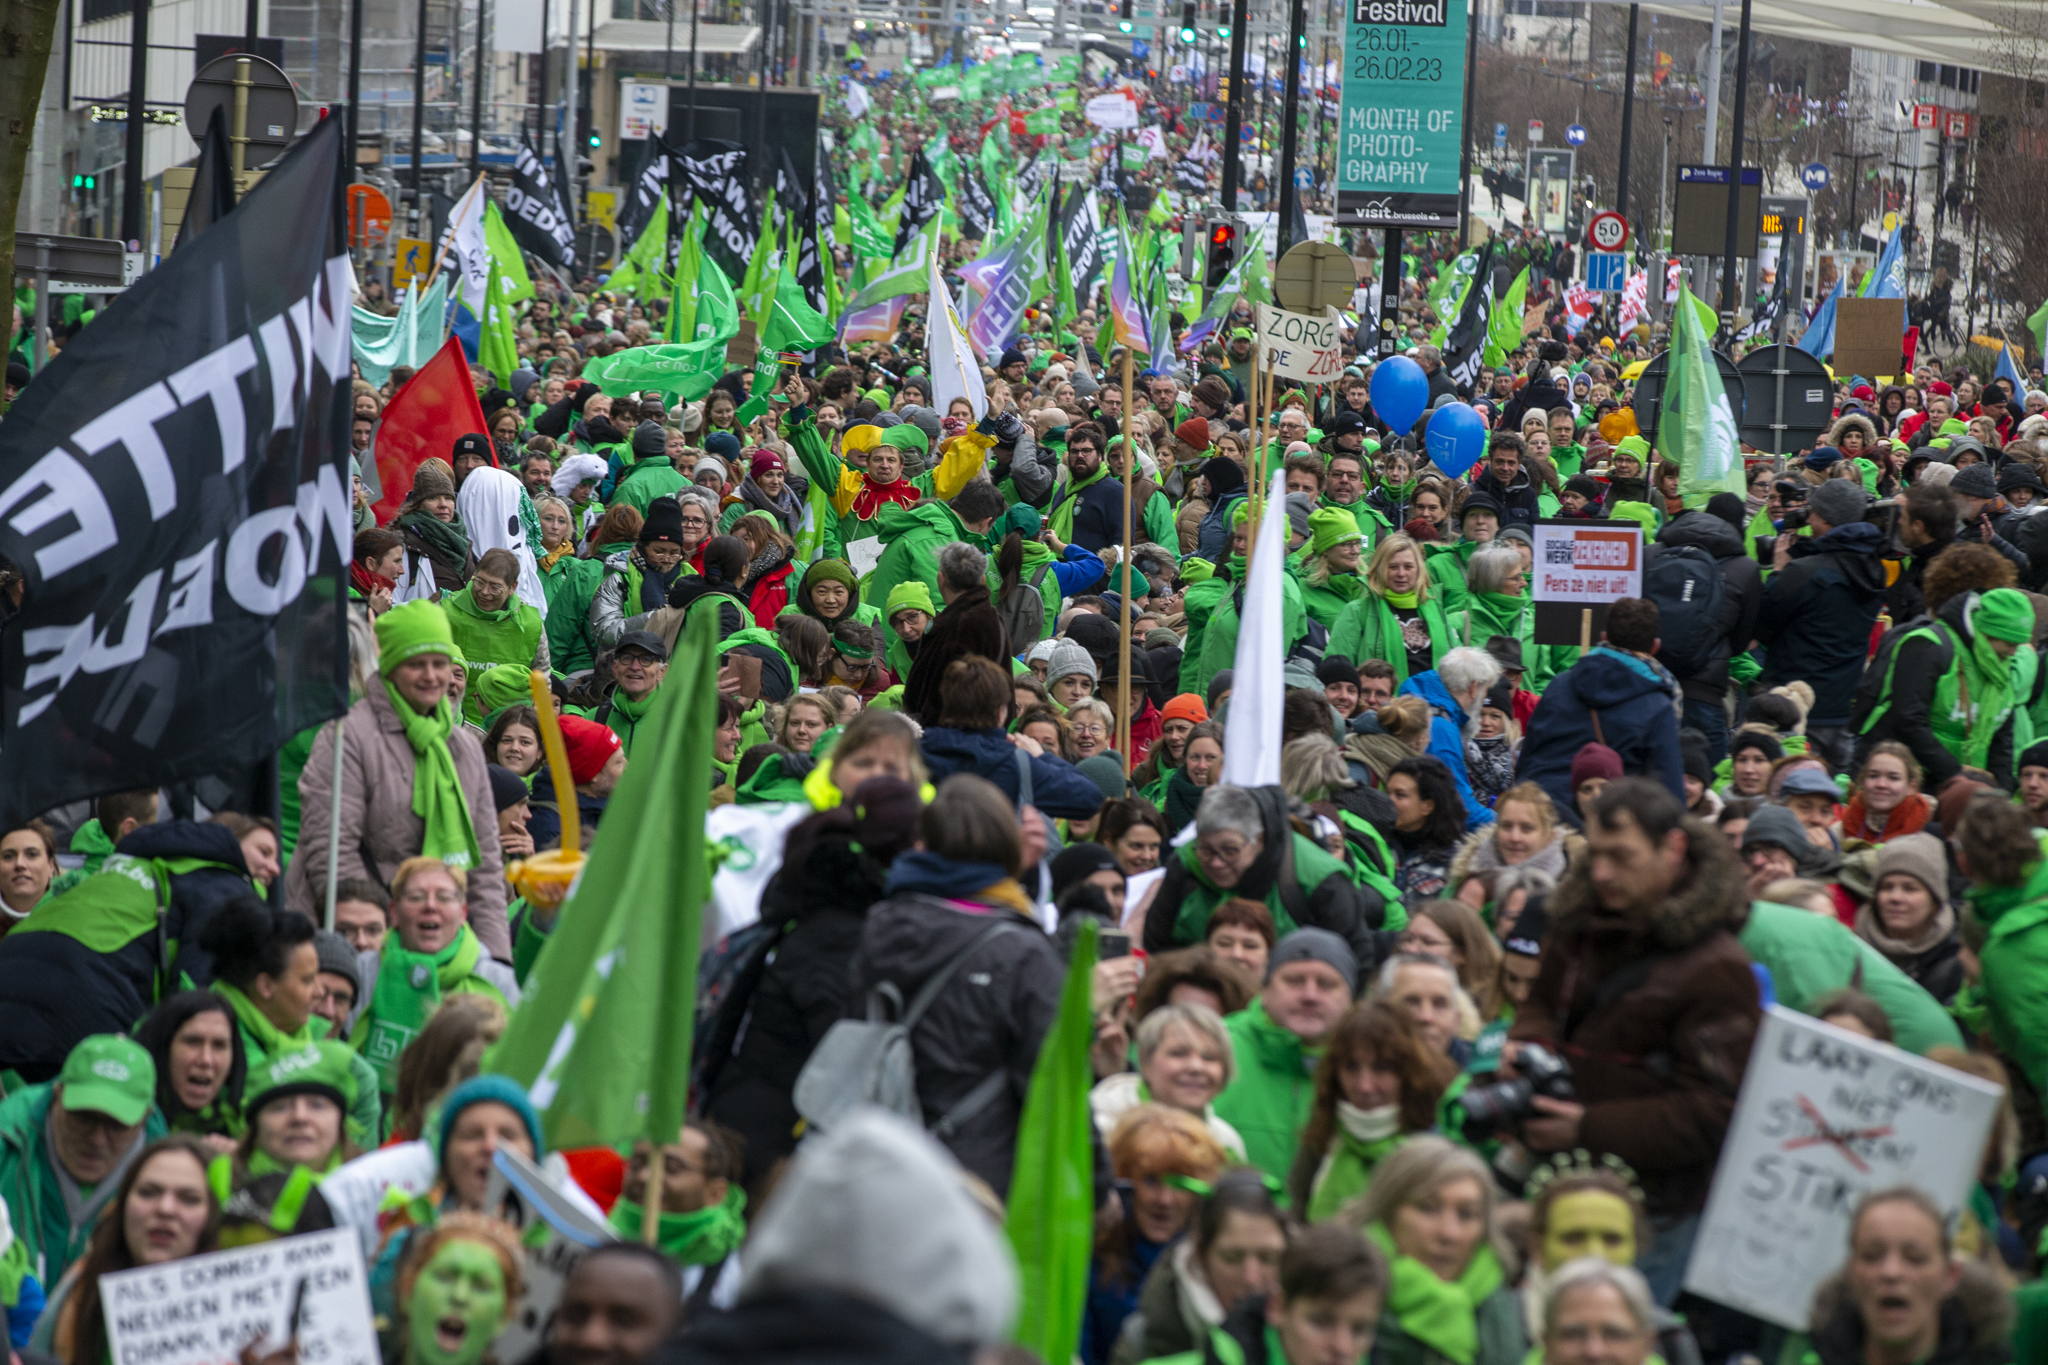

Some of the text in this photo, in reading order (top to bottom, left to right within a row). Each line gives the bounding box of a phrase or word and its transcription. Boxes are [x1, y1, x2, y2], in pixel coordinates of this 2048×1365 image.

[1357, 0, 1444, 24] Festival
[1354, 56, 1443, 81] 26.02.23
[1350, 107, 1454, 132] MONTH OF
[1347, 133, 1423, 158] PHOTO-
[1346, 159, 1430, 184] GRAPHY
[1599, 222, 1620, 237] 50
[1267, 311, 1334, 348] ZORG
[1267, 349, 1292, 367] DE
[1545, 574, 1628, 594] Pers ze niet uit!
[114, 1275, 168, 1302] ALS
[116, 1293, 220, 1332] NEUKEN
[230, 1277, 283, 1310] MET
